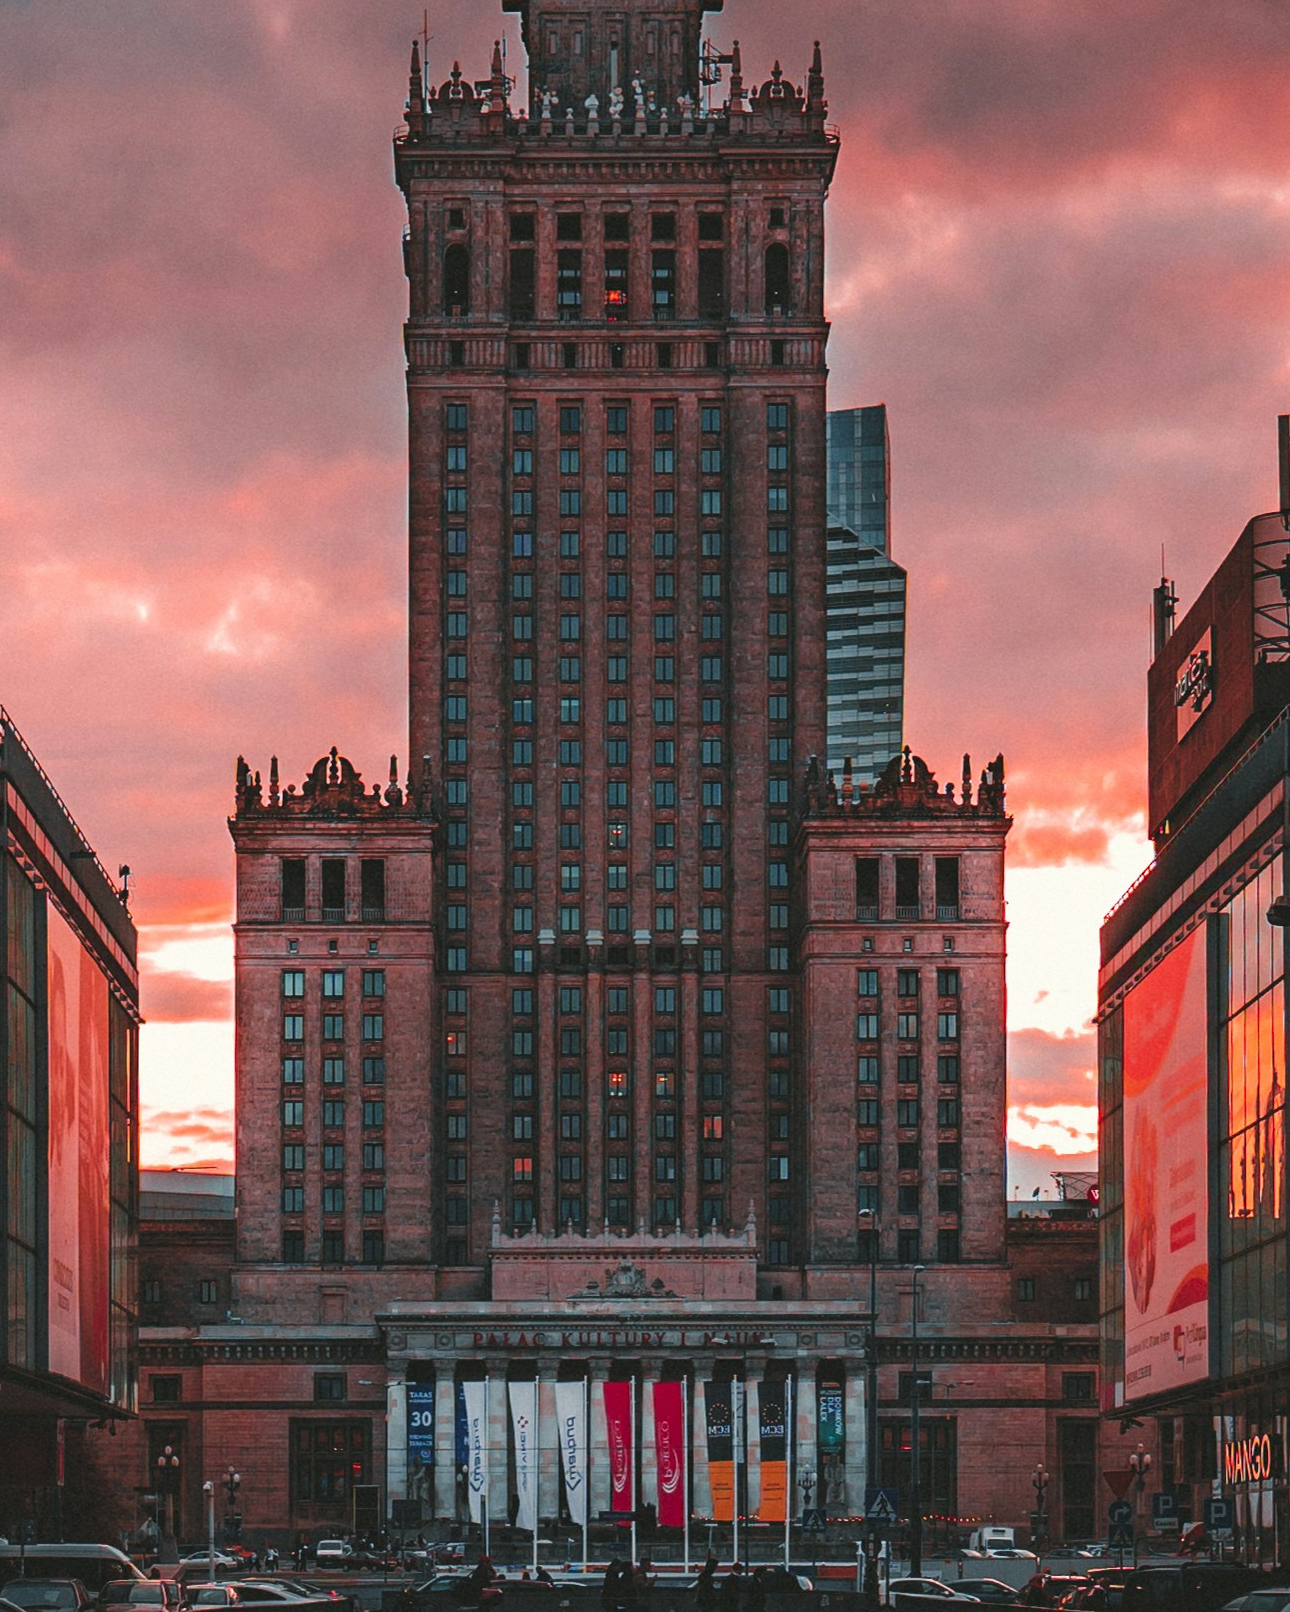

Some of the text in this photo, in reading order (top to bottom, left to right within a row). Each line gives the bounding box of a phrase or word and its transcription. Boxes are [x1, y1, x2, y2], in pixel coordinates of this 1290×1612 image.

[473, 1331, 546, 1348] PAŁAC
[561, 1331, 666, 1348] KULTURY
[680, 1331, 687, 1348] I
[410, 1411, 432, 1427] 30
[1225, 1433, 1272, 1485] MANGO
[1159, 1495, 1173, 1515] P
[1210, 1502, 1227, 1524] P
